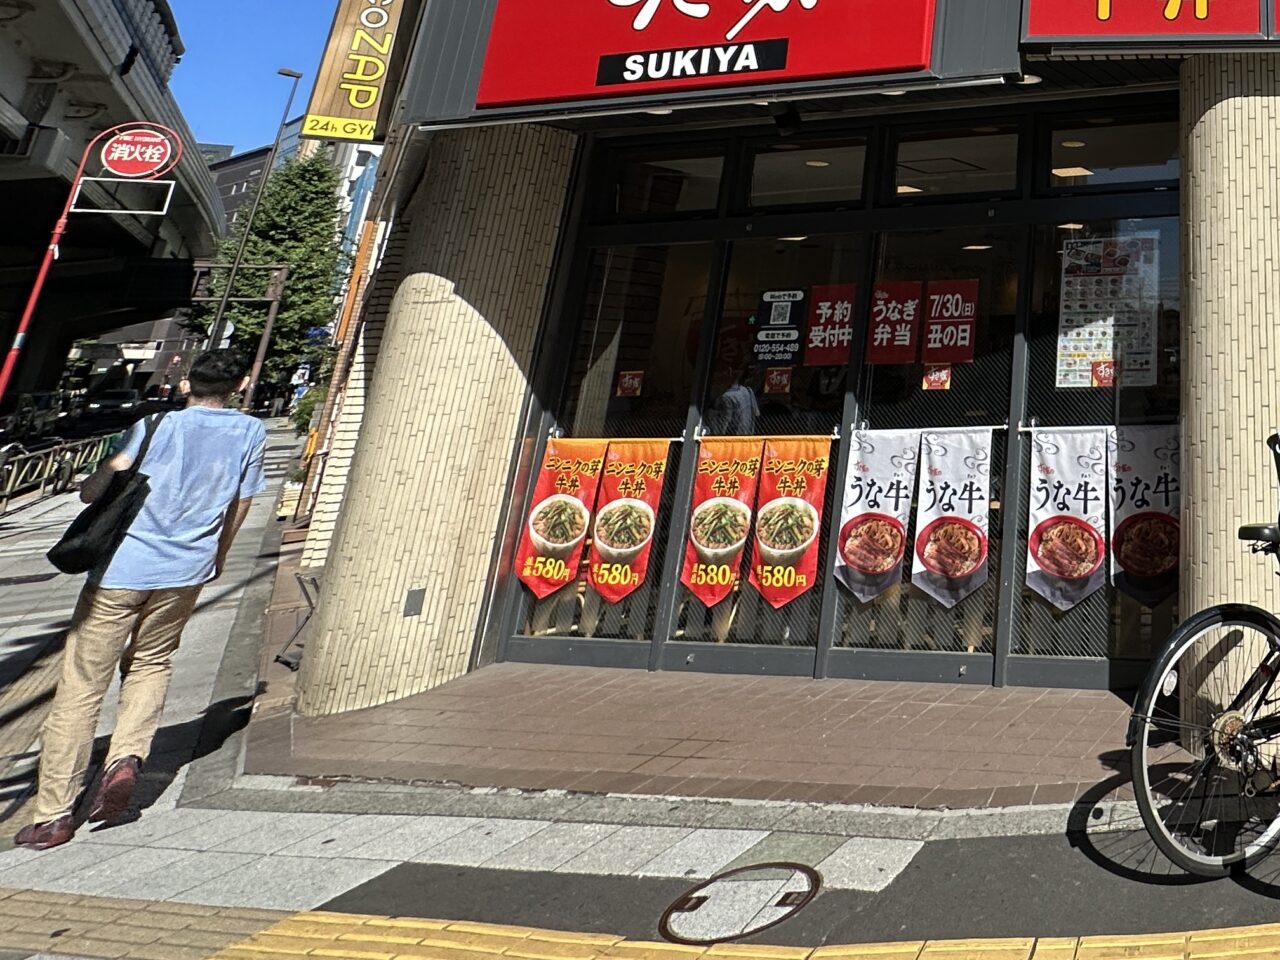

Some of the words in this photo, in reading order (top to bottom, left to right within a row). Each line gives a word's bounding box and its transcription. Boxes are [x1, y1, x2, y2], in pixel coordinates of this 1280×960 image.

[622, 43, 760, 81] SUKIYA
[308, 119, 338, 133] 24h
[108, 143, 165, 163] 消火栓
[815, 300, 852, 324] 予約
[872, 298, 920, 322] うなぎ
[808, 324, 854, 348] 受付中
[873, 323, 912, 346] 弁当
[927, 324, 972, 348] 丑の日
[545, 457, 602, 478] ニンニクの芽
[605, 461, 665, 481] ニンニクの芽
[699, 457, 760, 477] ニンニクの芽
[764, 458, 826, 478] ニンニクの芽
[555, 475, 581, 494] 牛丼
[618, 479, 647, 498] 牛丼
[711, 476, 740, 496] 牛丼
[776, 476, 808, 496] 牛丼
[847, 475, 910, 512] うな牛
[1036, 477, 1102, 515] うな牛
[1113, 471, 1180, 511] うな牛
[924, 480, 986, 514] うな牛
[762, 565, 808, 588] 580円
